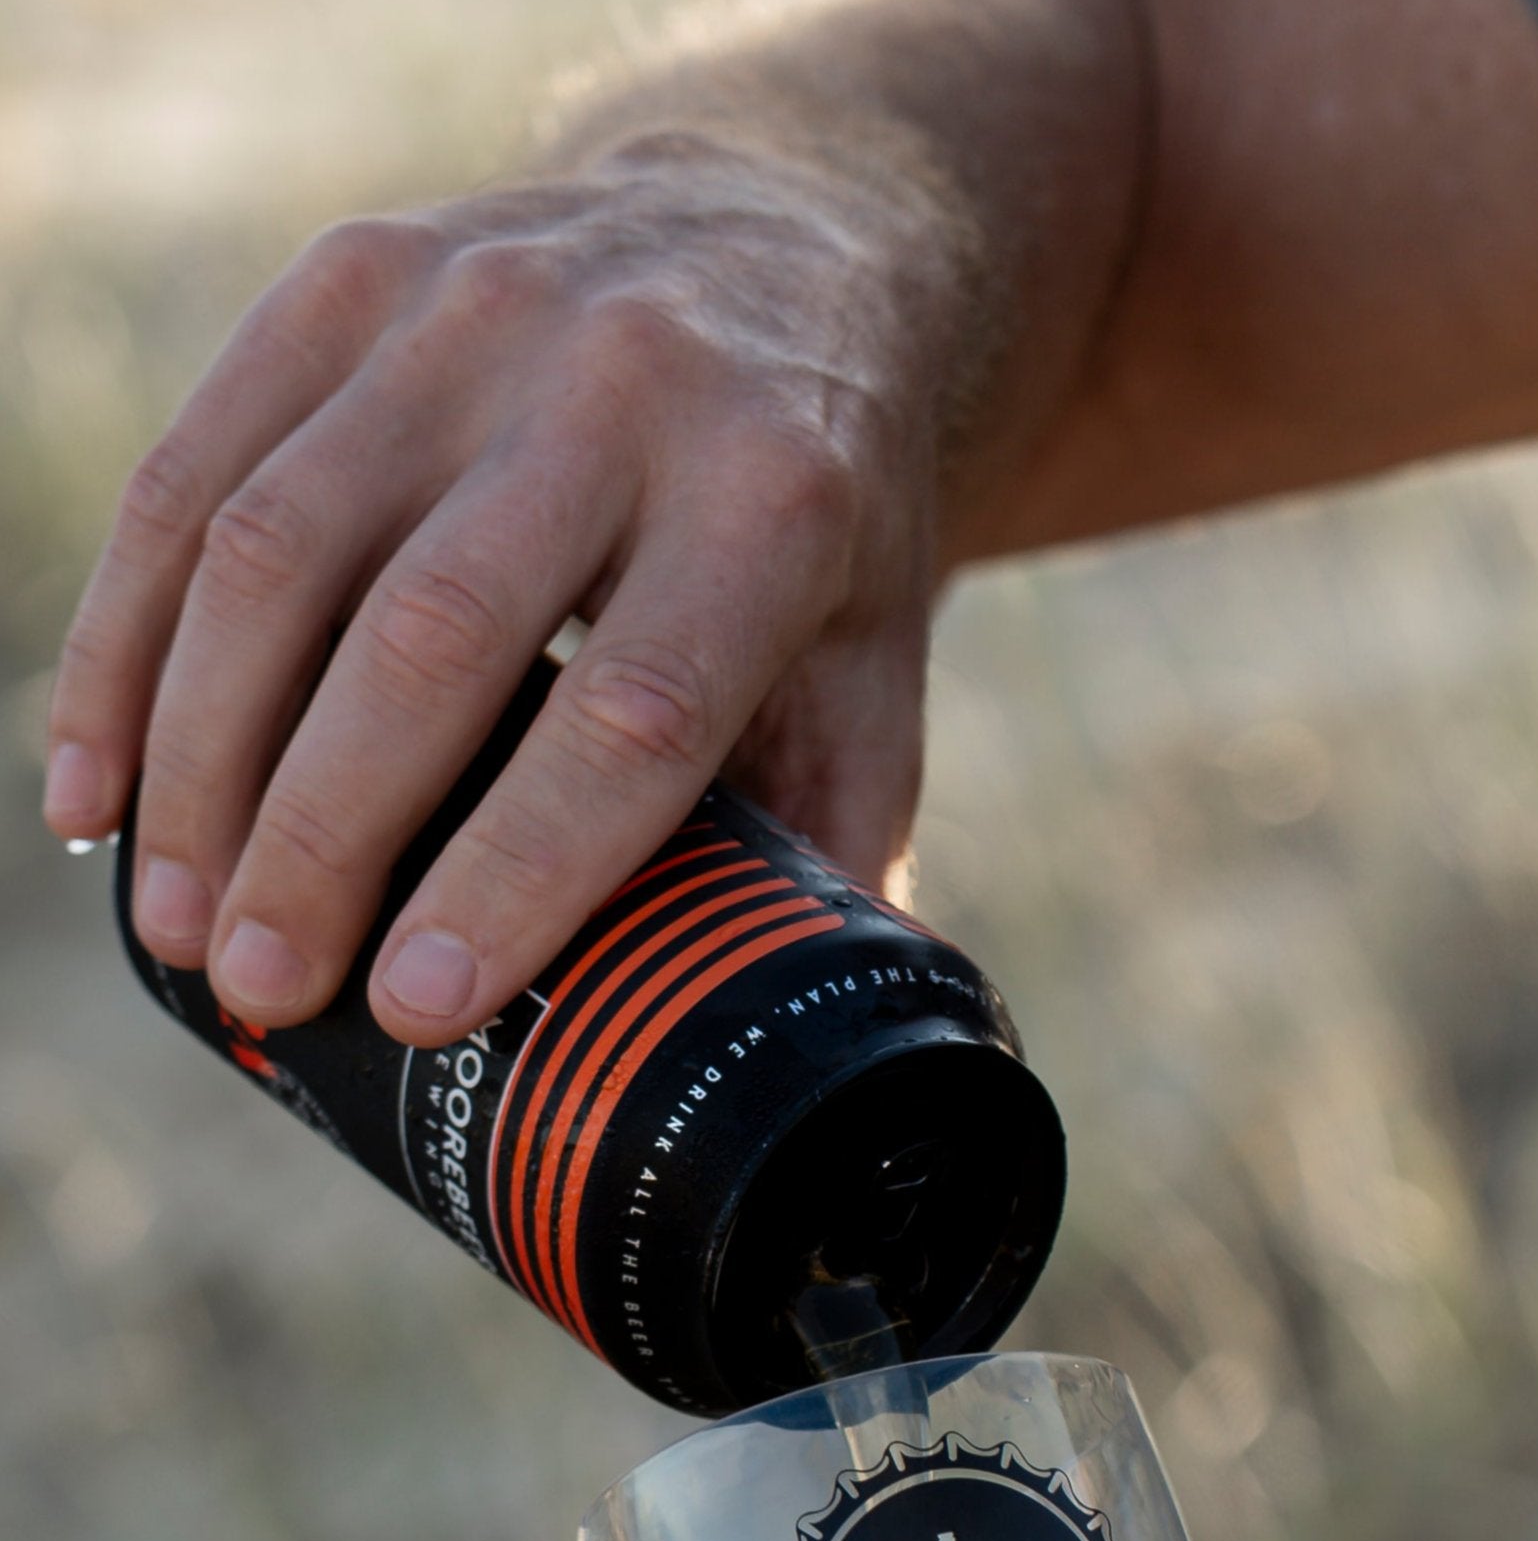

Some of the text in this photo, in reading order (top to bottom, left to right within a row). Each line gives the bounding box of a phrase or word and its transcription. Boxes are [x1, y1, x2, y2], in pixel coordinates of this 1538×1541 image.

[868, 966, 917, 986] THE
[727, 1024, 768, 1059] WE
[424, 1052, 451, 1189] EWING
[654, 1066, 722, 1153] DRINK
[630, 1166, 658, 1215] ALL
[621, 1237, 641, 1285] THE
